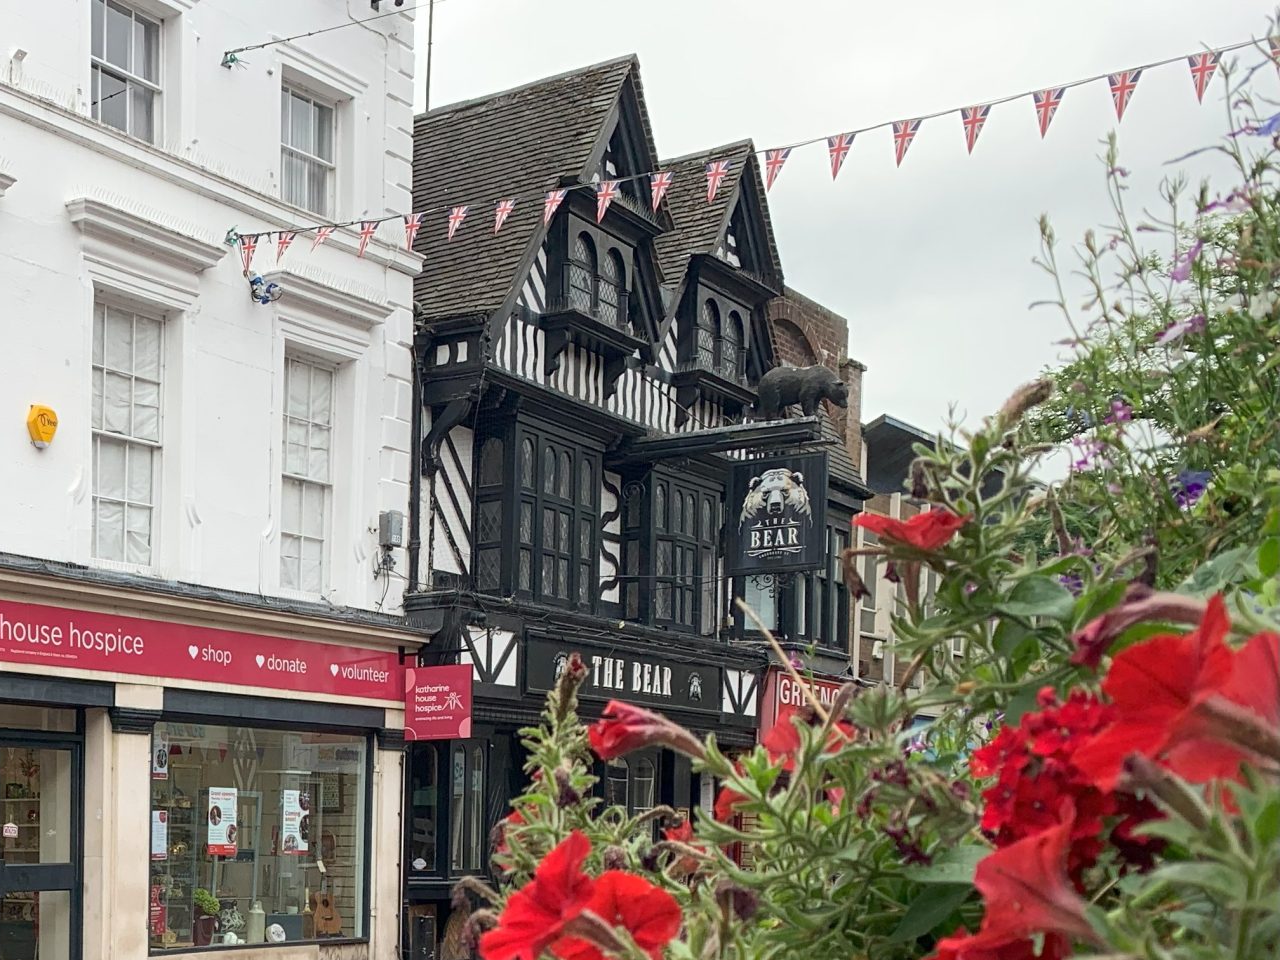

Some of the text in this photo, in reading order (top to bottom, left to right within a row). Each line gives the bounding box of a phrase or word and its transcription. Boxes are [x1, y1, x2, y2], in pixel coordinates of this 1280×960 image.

[765, 518, 785, 526] THE
[751, 528, 799, 548] BEAR
[0, 614, 63, 645] house
[70, 622, 144, 656] hospice
[202, 645, 232, 666] shop
[267, 654, 307, 673] donate
[342, 664, 389, 683] volunteer
[592, 656, 672, 697] THE BEAR
[416, 684, 450, 693] katharine
[415, 703, 442, 713] hospice
